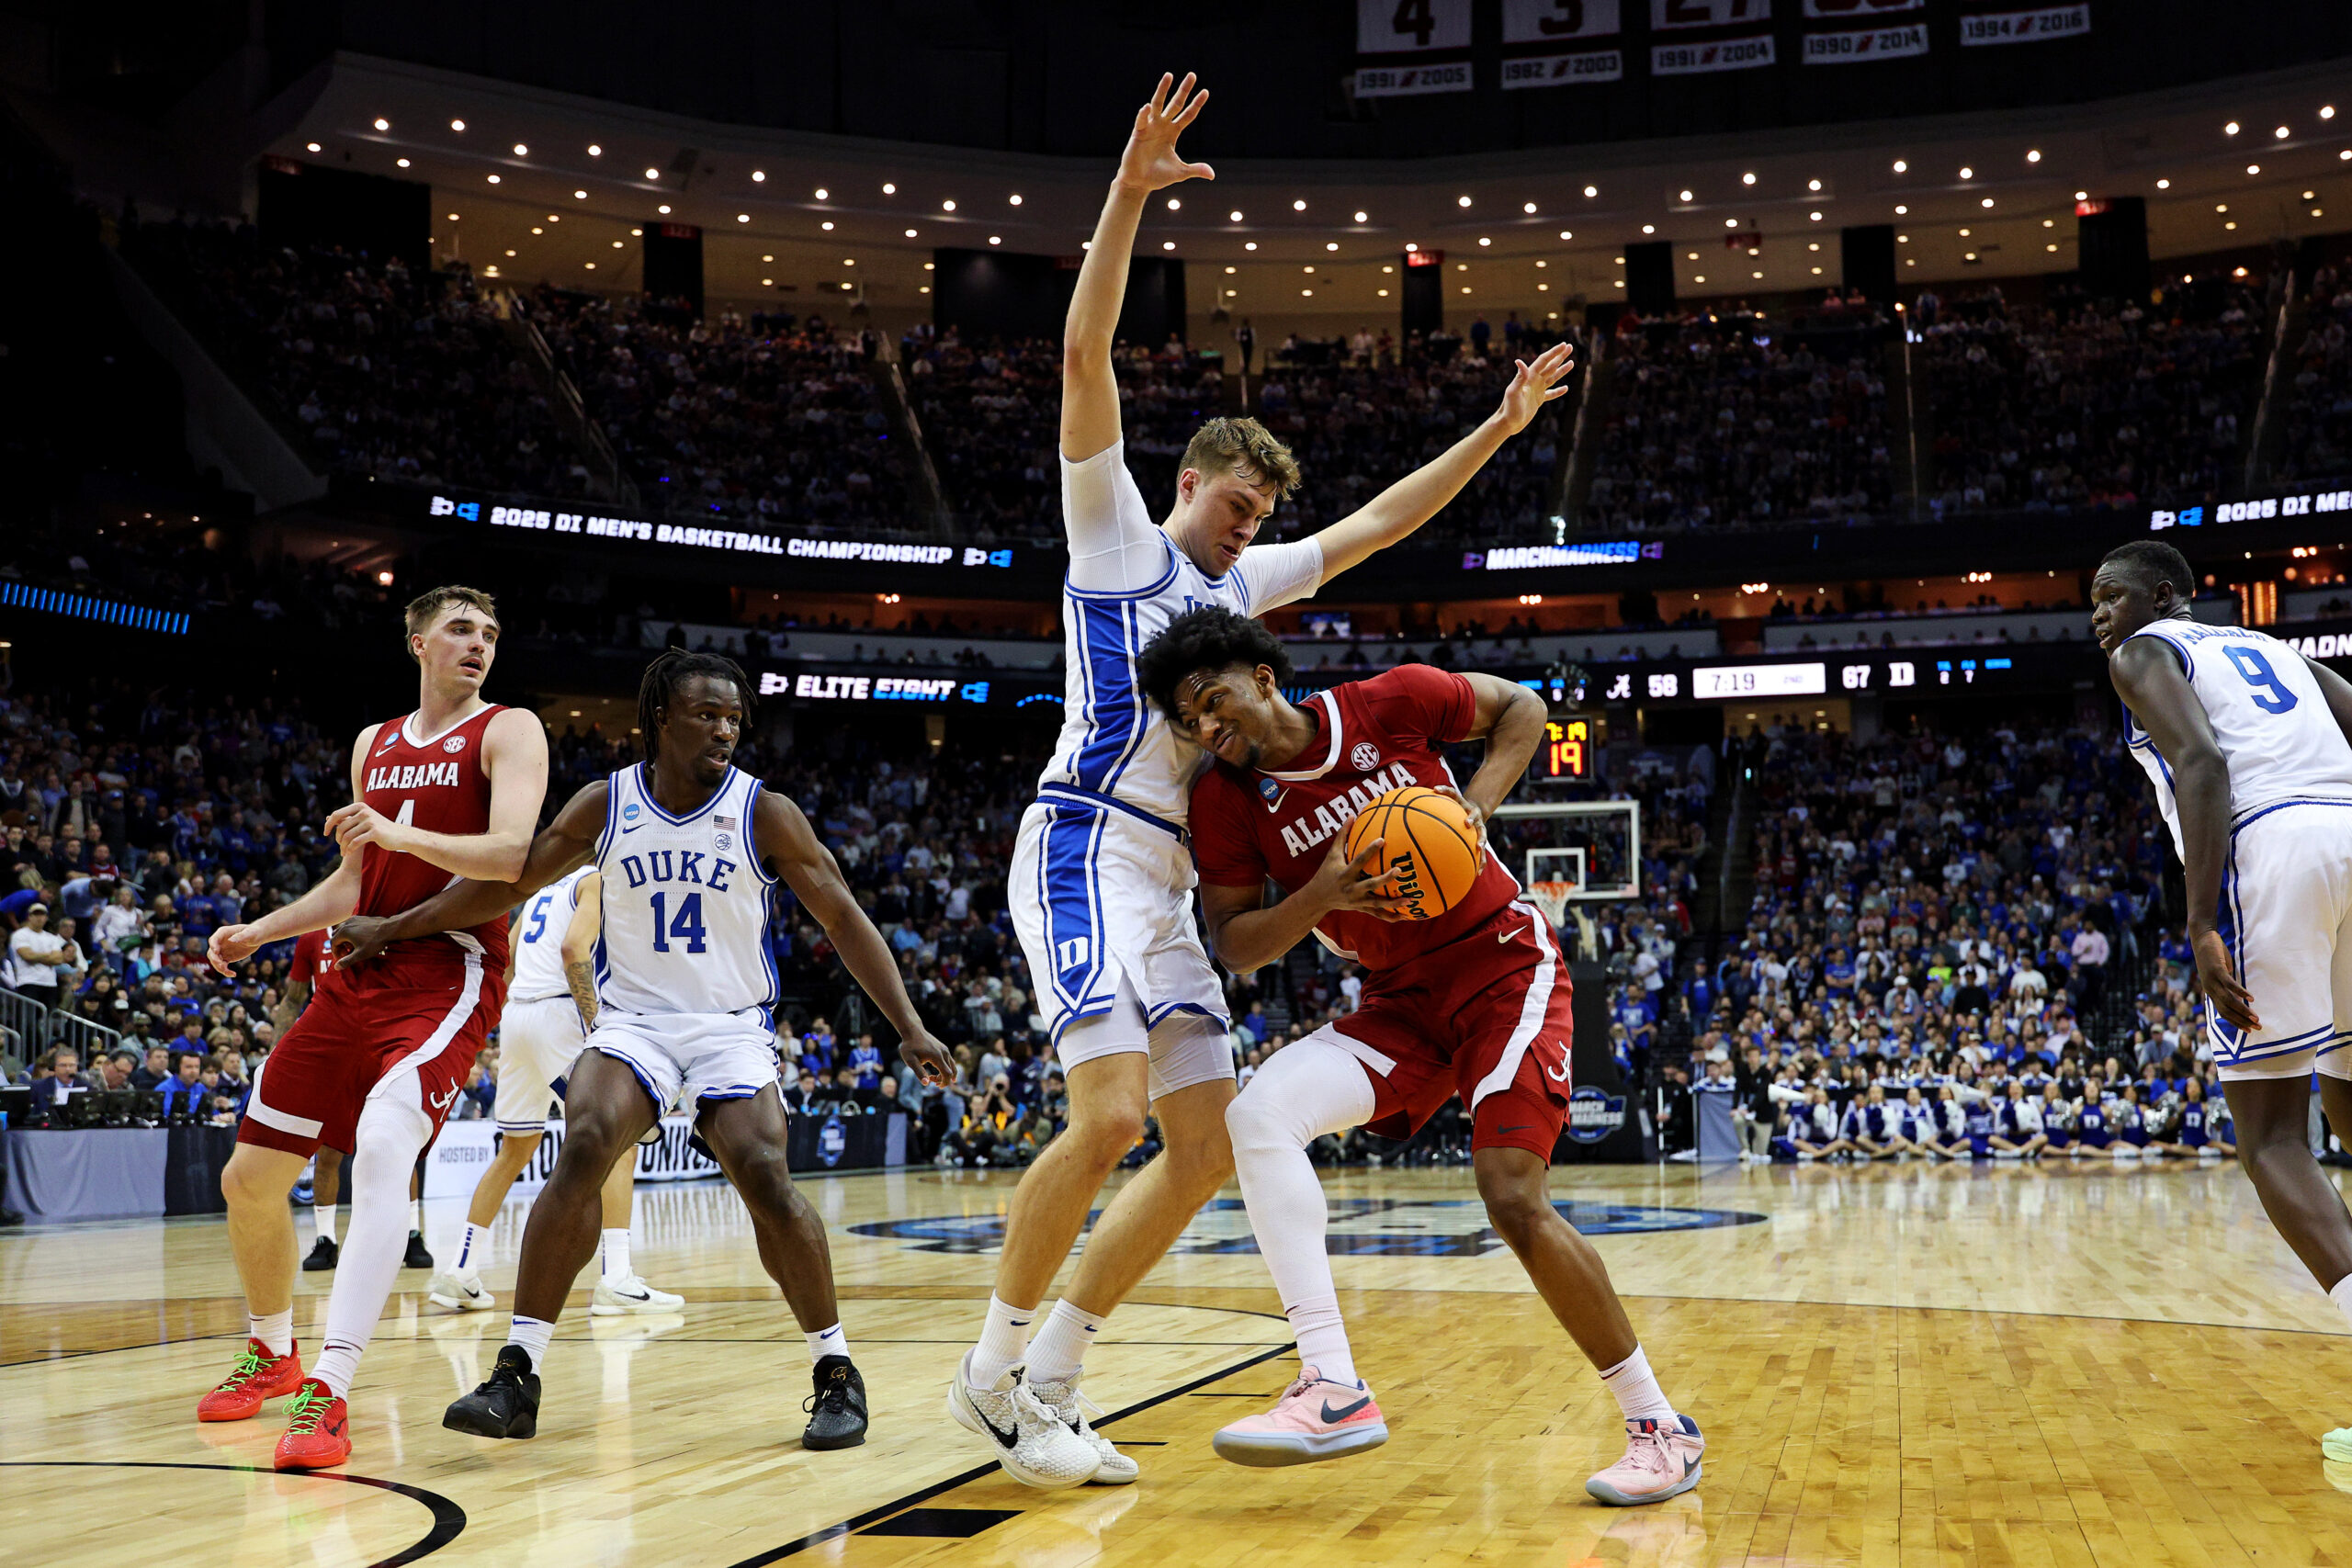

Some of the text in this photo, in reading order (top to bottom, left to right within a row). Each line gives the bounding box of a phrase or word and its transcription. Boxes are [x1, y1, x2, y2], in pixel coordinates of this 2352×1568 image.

[1968, 12, 2083, 38] 1994 2016
[1659, 44, 1768, 67] 1991 2004
[1809, 30, 1920, 54] 1990 2014
[1361, 68, 1465, 89] 1991 2005
[1506, 55, 1617, 81] 1982 2003
[2216, 491, 2352, 523] 2025 DI ME
[490, 506, 953, 564] 2025 DI MEN'S BASKETBALL CHAMPIONSHIP
[795, 674, 956, 701] ELITE EIGHT
[1648, 673, 1678, 698] 58
[1713, 672, 1755, 691] 7:19
[1842, 665, 1871, 689] 67
[2222, 645, 2299, 715] 9
[445, 736, 466, 753] SEC
[1544, 721, 1587, 741] 7:19
[1353, 745, 1377, 770] SEC
[1550, 741, 1582, 776] 19
[366, 761, 459, 793] ALABAMA
[1263, 783, 1279, 797] NCAA
[1280, 761, 1418, 858] ALABAMA
[620, 850, 737, 893] DUKE
[524, 897, 553, 943] 5
[650, 891, 706, 953] 14
[439, 1146, 490, 1163] HOSTED BY
